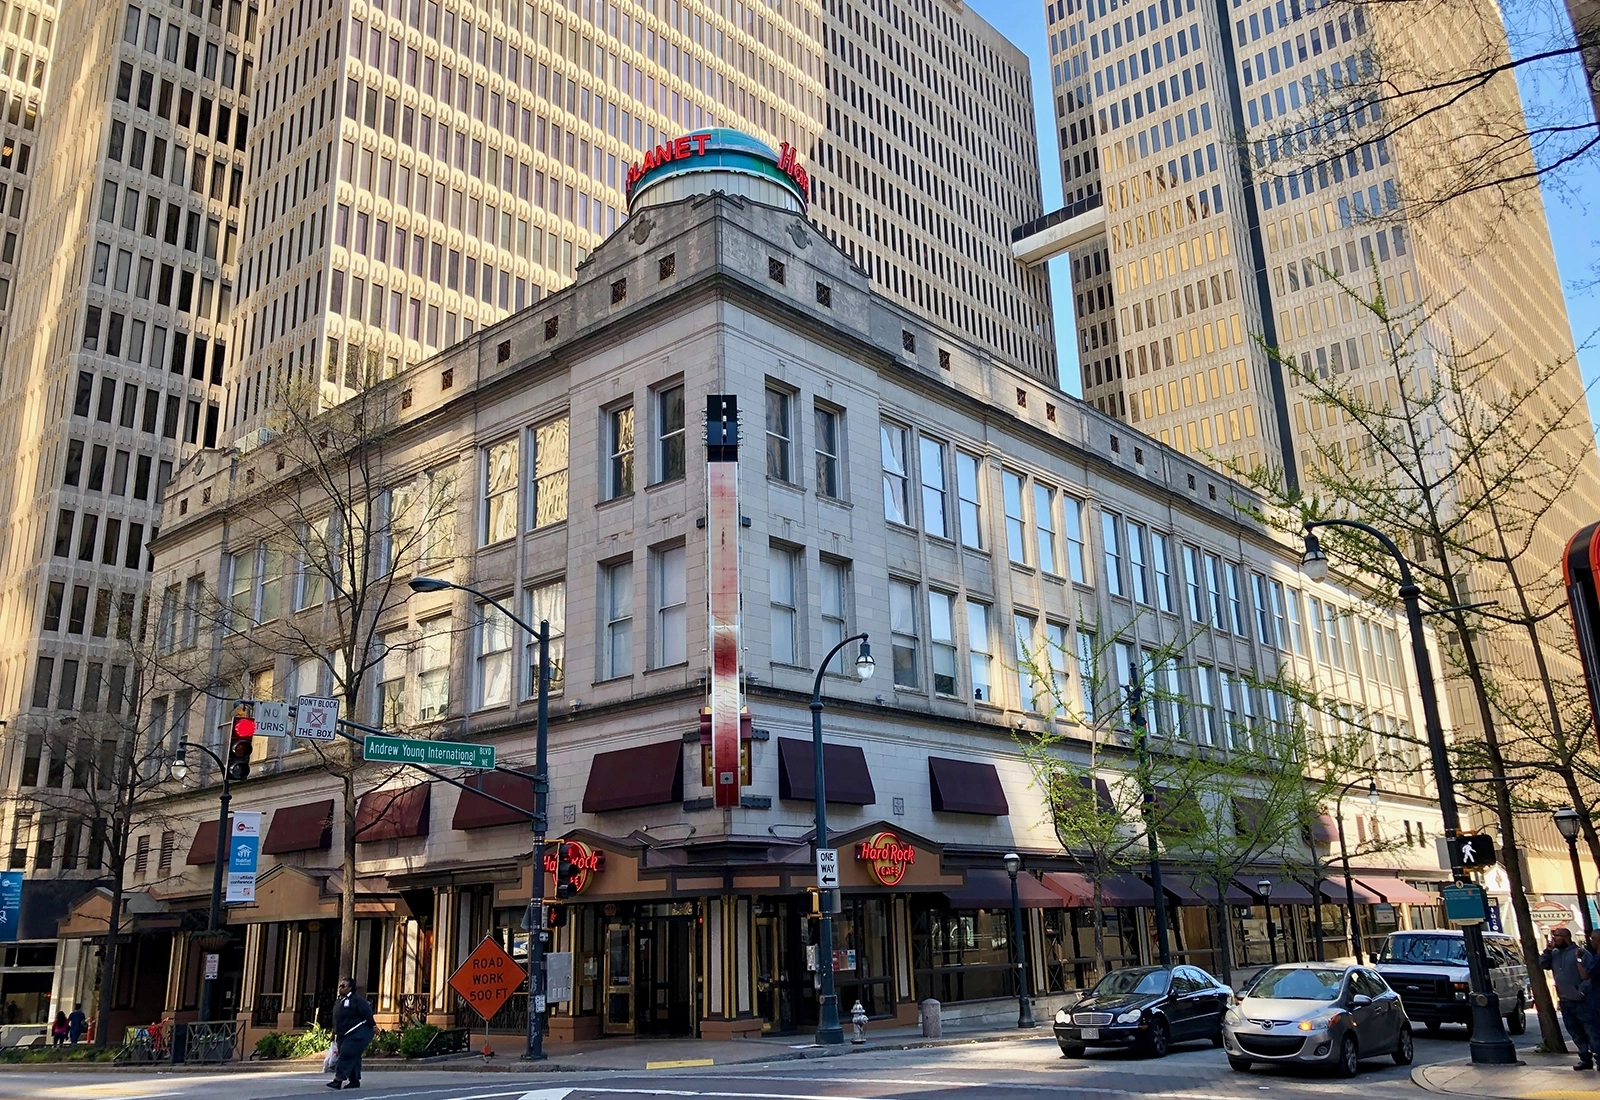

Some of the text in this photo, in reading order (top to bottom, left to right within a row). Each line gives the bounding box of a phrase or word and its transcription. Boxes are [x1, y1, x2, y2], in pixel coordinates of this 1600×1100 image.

[318, 700, 337, 709] BLOCK
[263, 708, 280, 718] NO
[256, 721, 285, 732] TURNS
[298, 727, 333, 738] THE BOX
[368, 741, 476, 762] Andrew Young International
[479, 746, 492, 756] BLVD
[481, 758, 489, 767] NE
[820, 852, 835, 862] ONE
[861, 842, 915, 865] Hard Rock
[820, 864, 835, 873] WAY
[880, 866, 899, 877] CAFE
[472, 957, 504, 970] ROAD
[472, 972, 504, 986] WORK
[469, 987, 509, 1002] 500 FT
